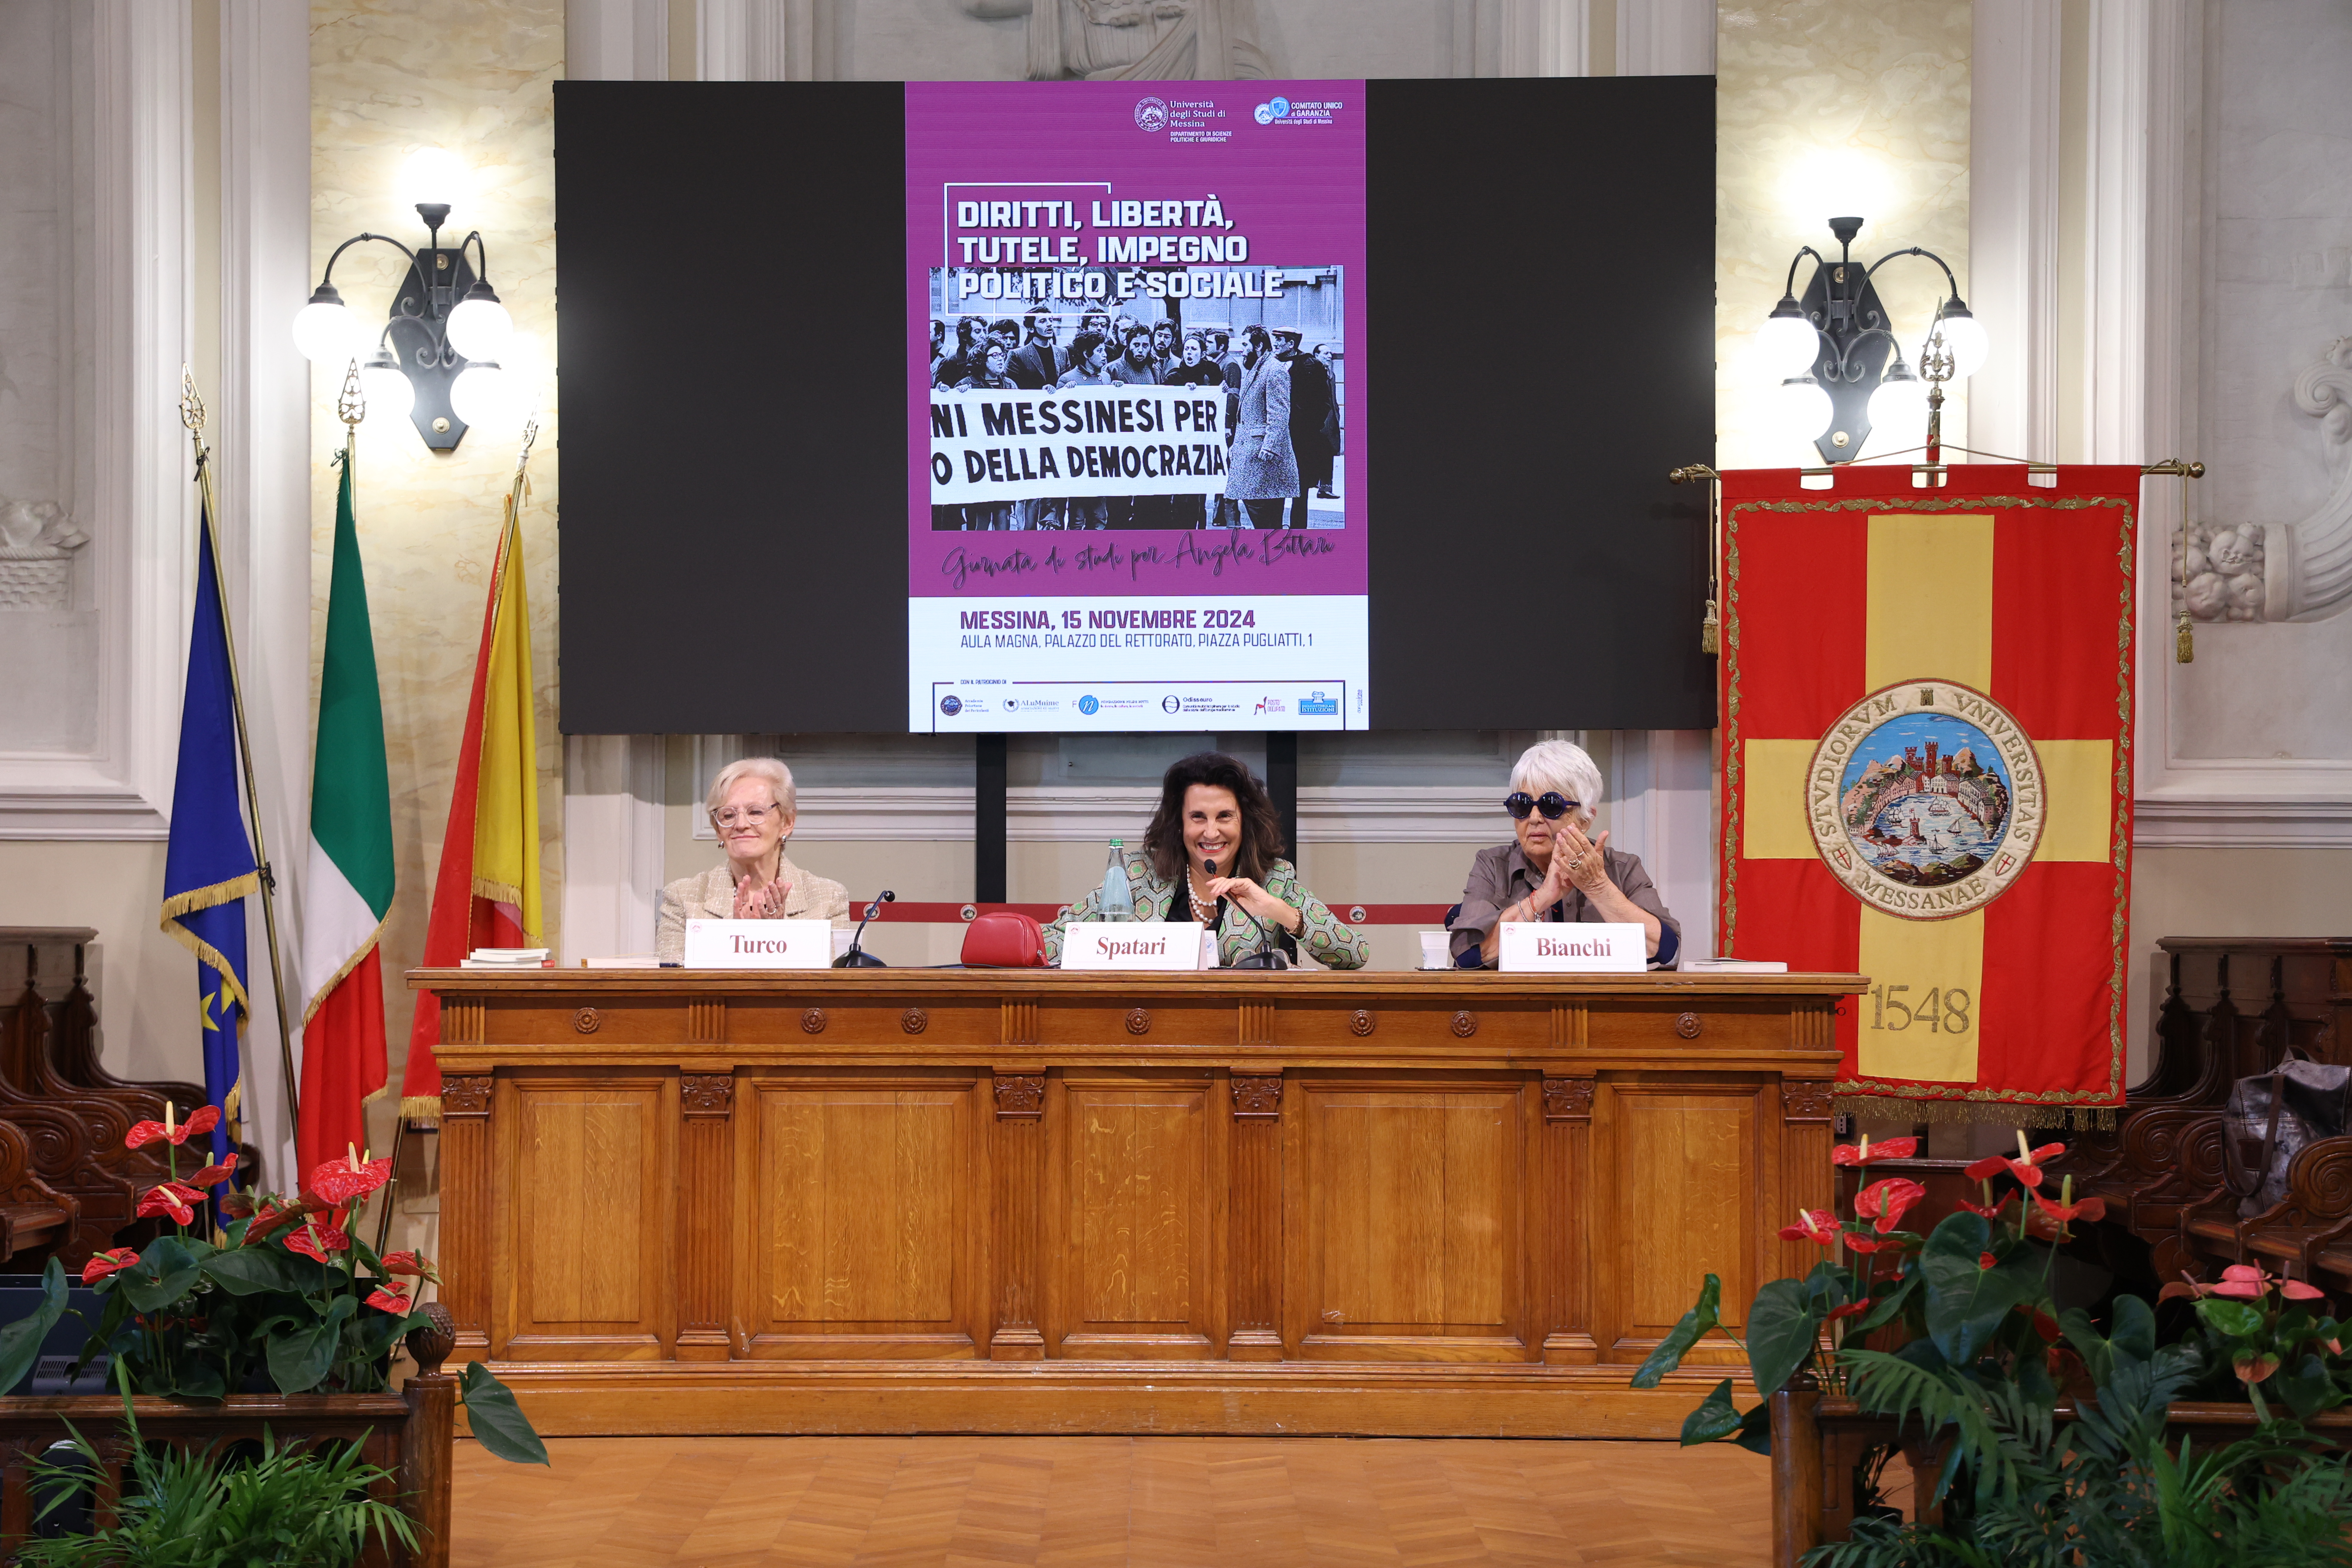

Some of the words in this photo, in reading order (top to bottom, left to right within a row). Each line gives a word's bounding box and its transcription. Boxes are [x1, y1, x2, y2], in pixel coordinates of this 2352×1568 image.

[1170, 100, 1214, 108] Università
[1170, 110, 1191, 119] degli
[957, 200, 1083, 232] DIRITTI,
[1091, 193, 1234, 231] LIBERTÀ,
[957, 236, 1088, 266] TUTELE,
[1098, 236, 1248, 263] IMPEGNO
[959, 272, 1106, 299] POLITICO
[1117, 272, 1136, 298] E
[1146, 272, 1283, 298] SOCIALE
[982, 399, 1164, 437] MESSINESI
[1173, 400, 1217, 432] PER
[932, 452, 953, 485] O
[963, 446, 1060, 484] DELLA
[1066, 444, 1226, 478] DEMOCRAZIA
[941, 546, 1037, 589] Giornata
[1044, 544, 1066, 574] di
[1074, 541, 1123, 572] studi
[1130, 545, 1164, 581] per
[1162, 527, 1253, 576] Angela
[1258, 524, 1334, 566] Bottari
[961, 610, 1056, 631] MESSINA,
[1062, 610, 1081, 629] 15
[1089, 610, 1197, 628] NOVEMBRE
[1204, 609, 1256, 628] 2024
[961, 634, 991, 648] AULA
[995, 634, 1041, 649] MAGNA,
[1045, 634, 1096, 647] PALAZZO
[1100, 634, 1121, 647] DEL
[1126, 634, 1195, 648] RETTORATO,
[1199, 634, 1240, 647] PIAZZA
[1243, 633, 1305, 647] PUGLIATTI,
[1308, 633, 1312, 646] 1
[1813, 694, 1897, 837] STVDIORVM
[1954, 693, 2037, 843] VNIVERSITAS
[1858, 869, 1986, 910] MESSANAE
[729, 935, 787, 953] Turco
[1096, 936, 1166, 960] Spatari
[1536, 937, 1612, 957] Bianchi
[1871, 984, 1970, 1034] 1548
